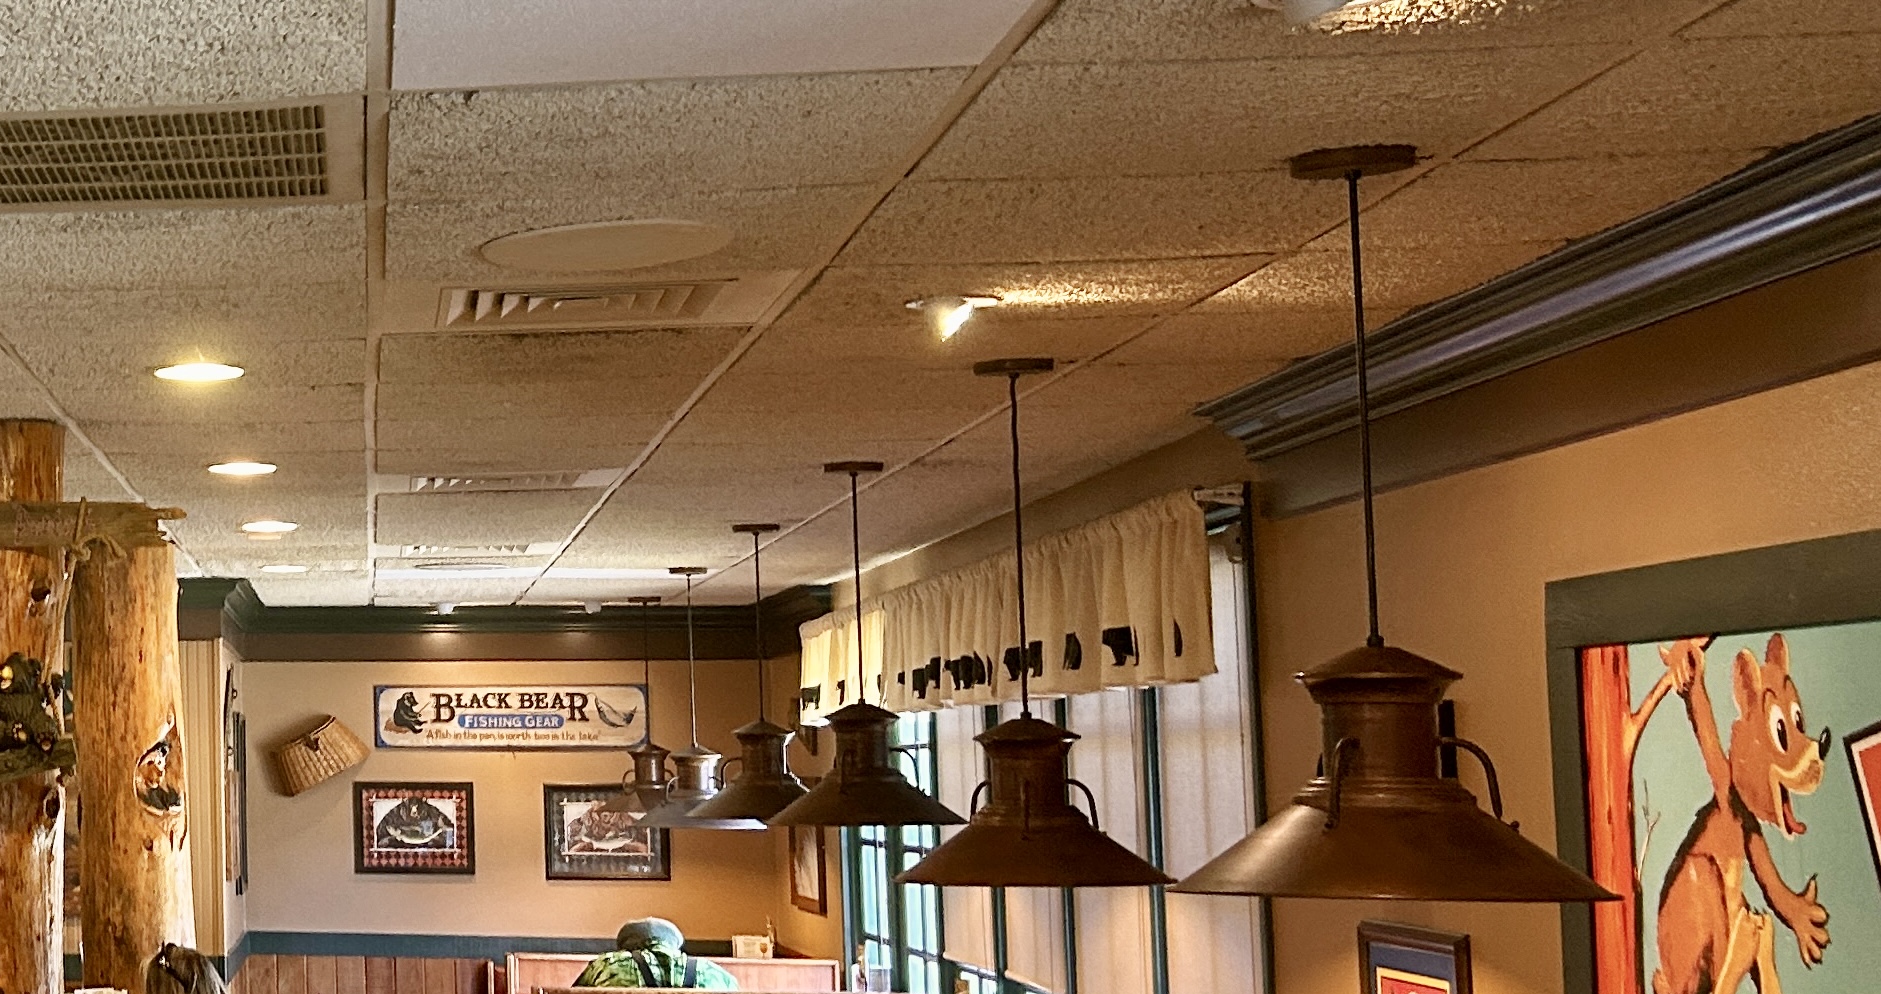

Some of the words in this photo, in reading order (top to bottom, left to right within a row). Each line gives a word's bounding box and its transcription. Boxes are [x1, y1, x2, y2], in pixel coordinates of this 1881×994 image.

[430, 692, 512, 724] BLACK
[519, 692, 591, 723] BEAR
[463, 714, 521, 728] FISHING
[524, 715, 561, 728] GEAR
